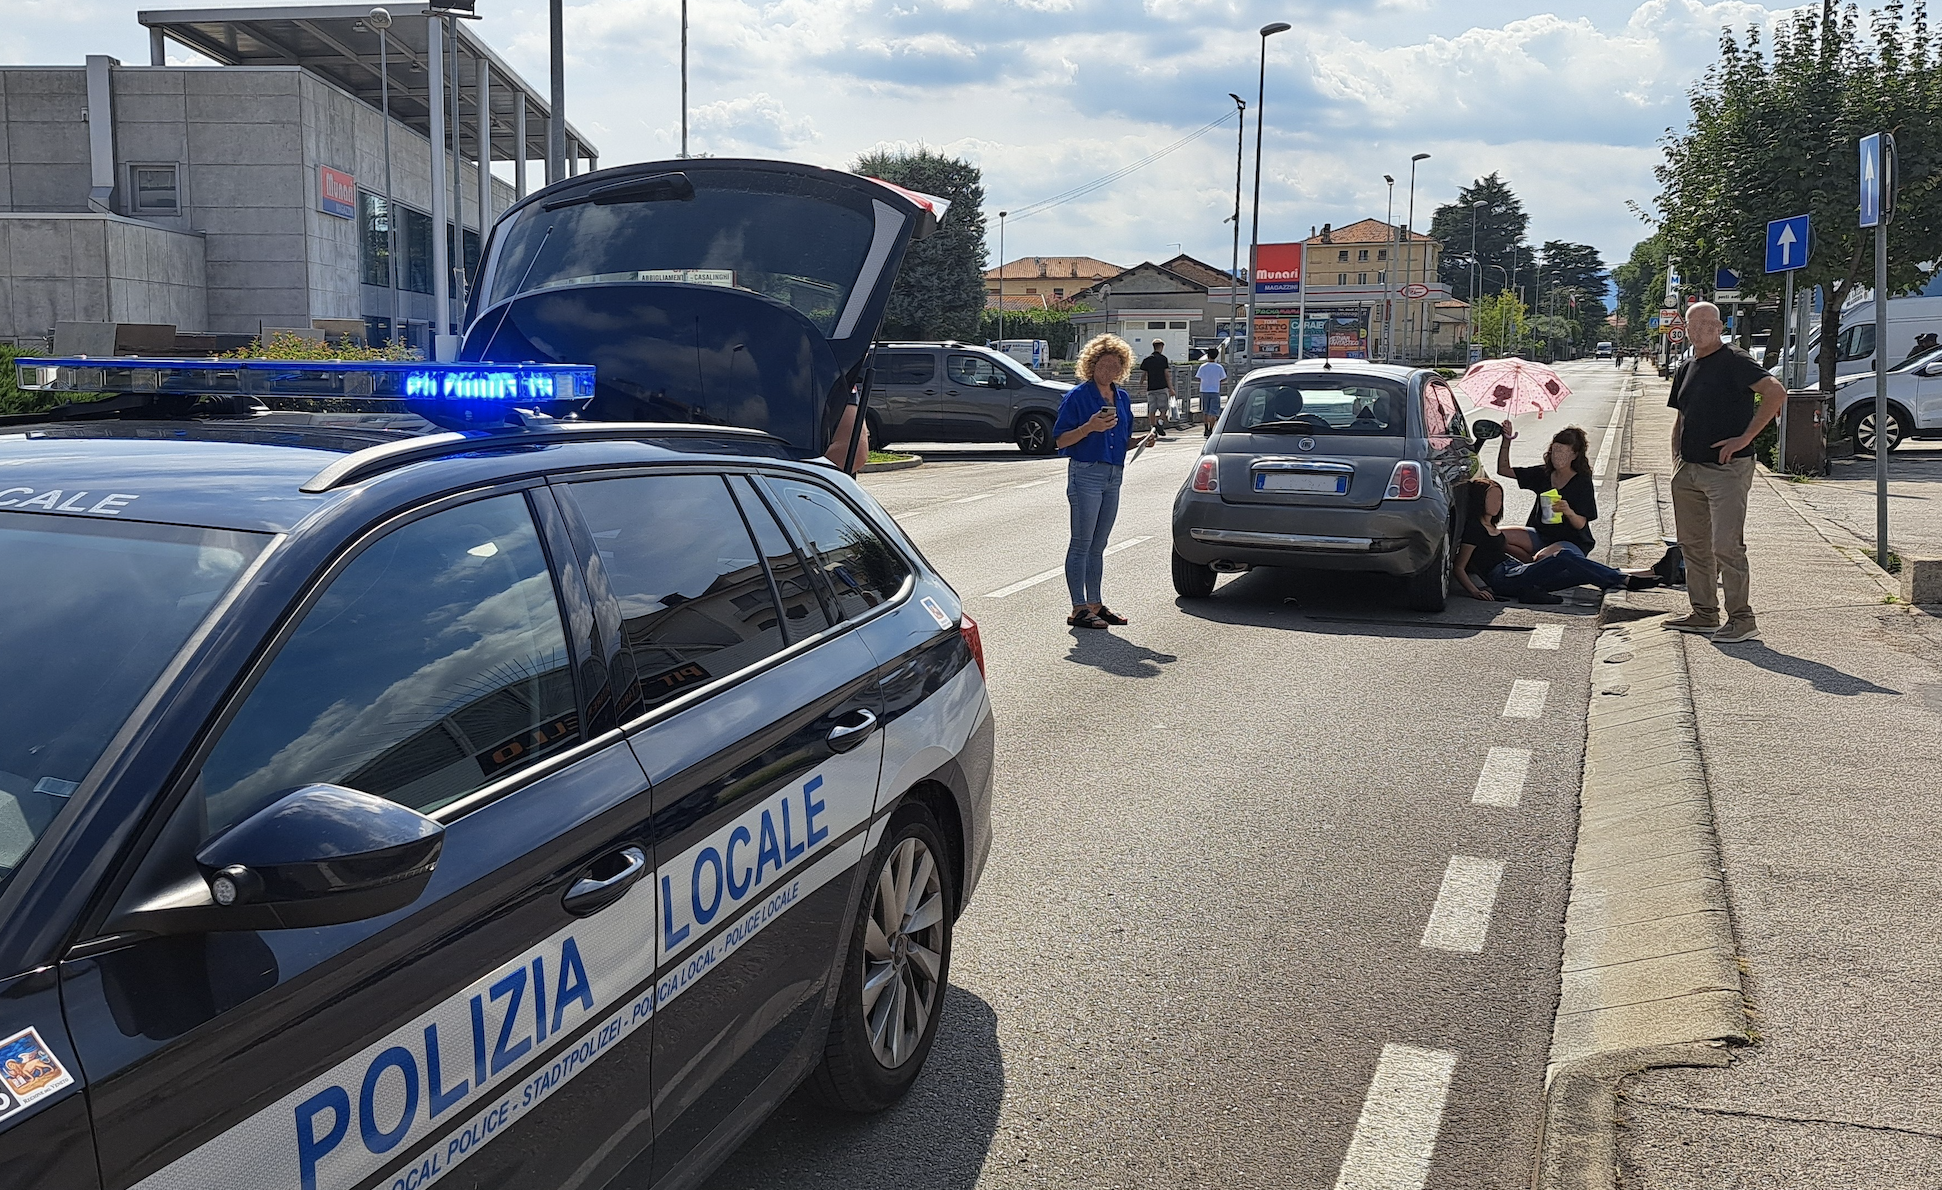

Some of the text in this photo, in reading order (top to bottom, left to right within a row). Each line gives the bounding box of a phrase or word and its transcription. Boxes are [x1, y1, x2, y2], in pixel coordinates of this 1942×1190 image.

[326, 172, 354, 203] Munari
[1256, 268, 1299, 279] Munari
[1033, 342, 1039, 354] P
[1672, 331, 1682, 340] 30
[661, 774, 829, 952] LOCALE
[447, 1100, 510, 1166] POLICE
[522, 1016, 622, 1107] STADTPOLIZEI
[680, 946, 716, 987] LOCAL
[725, 912, 760, 953] POLICE
[761, 881, 800, 922] LOCALE
[294, 936, 595, 1190] POLIZIA
